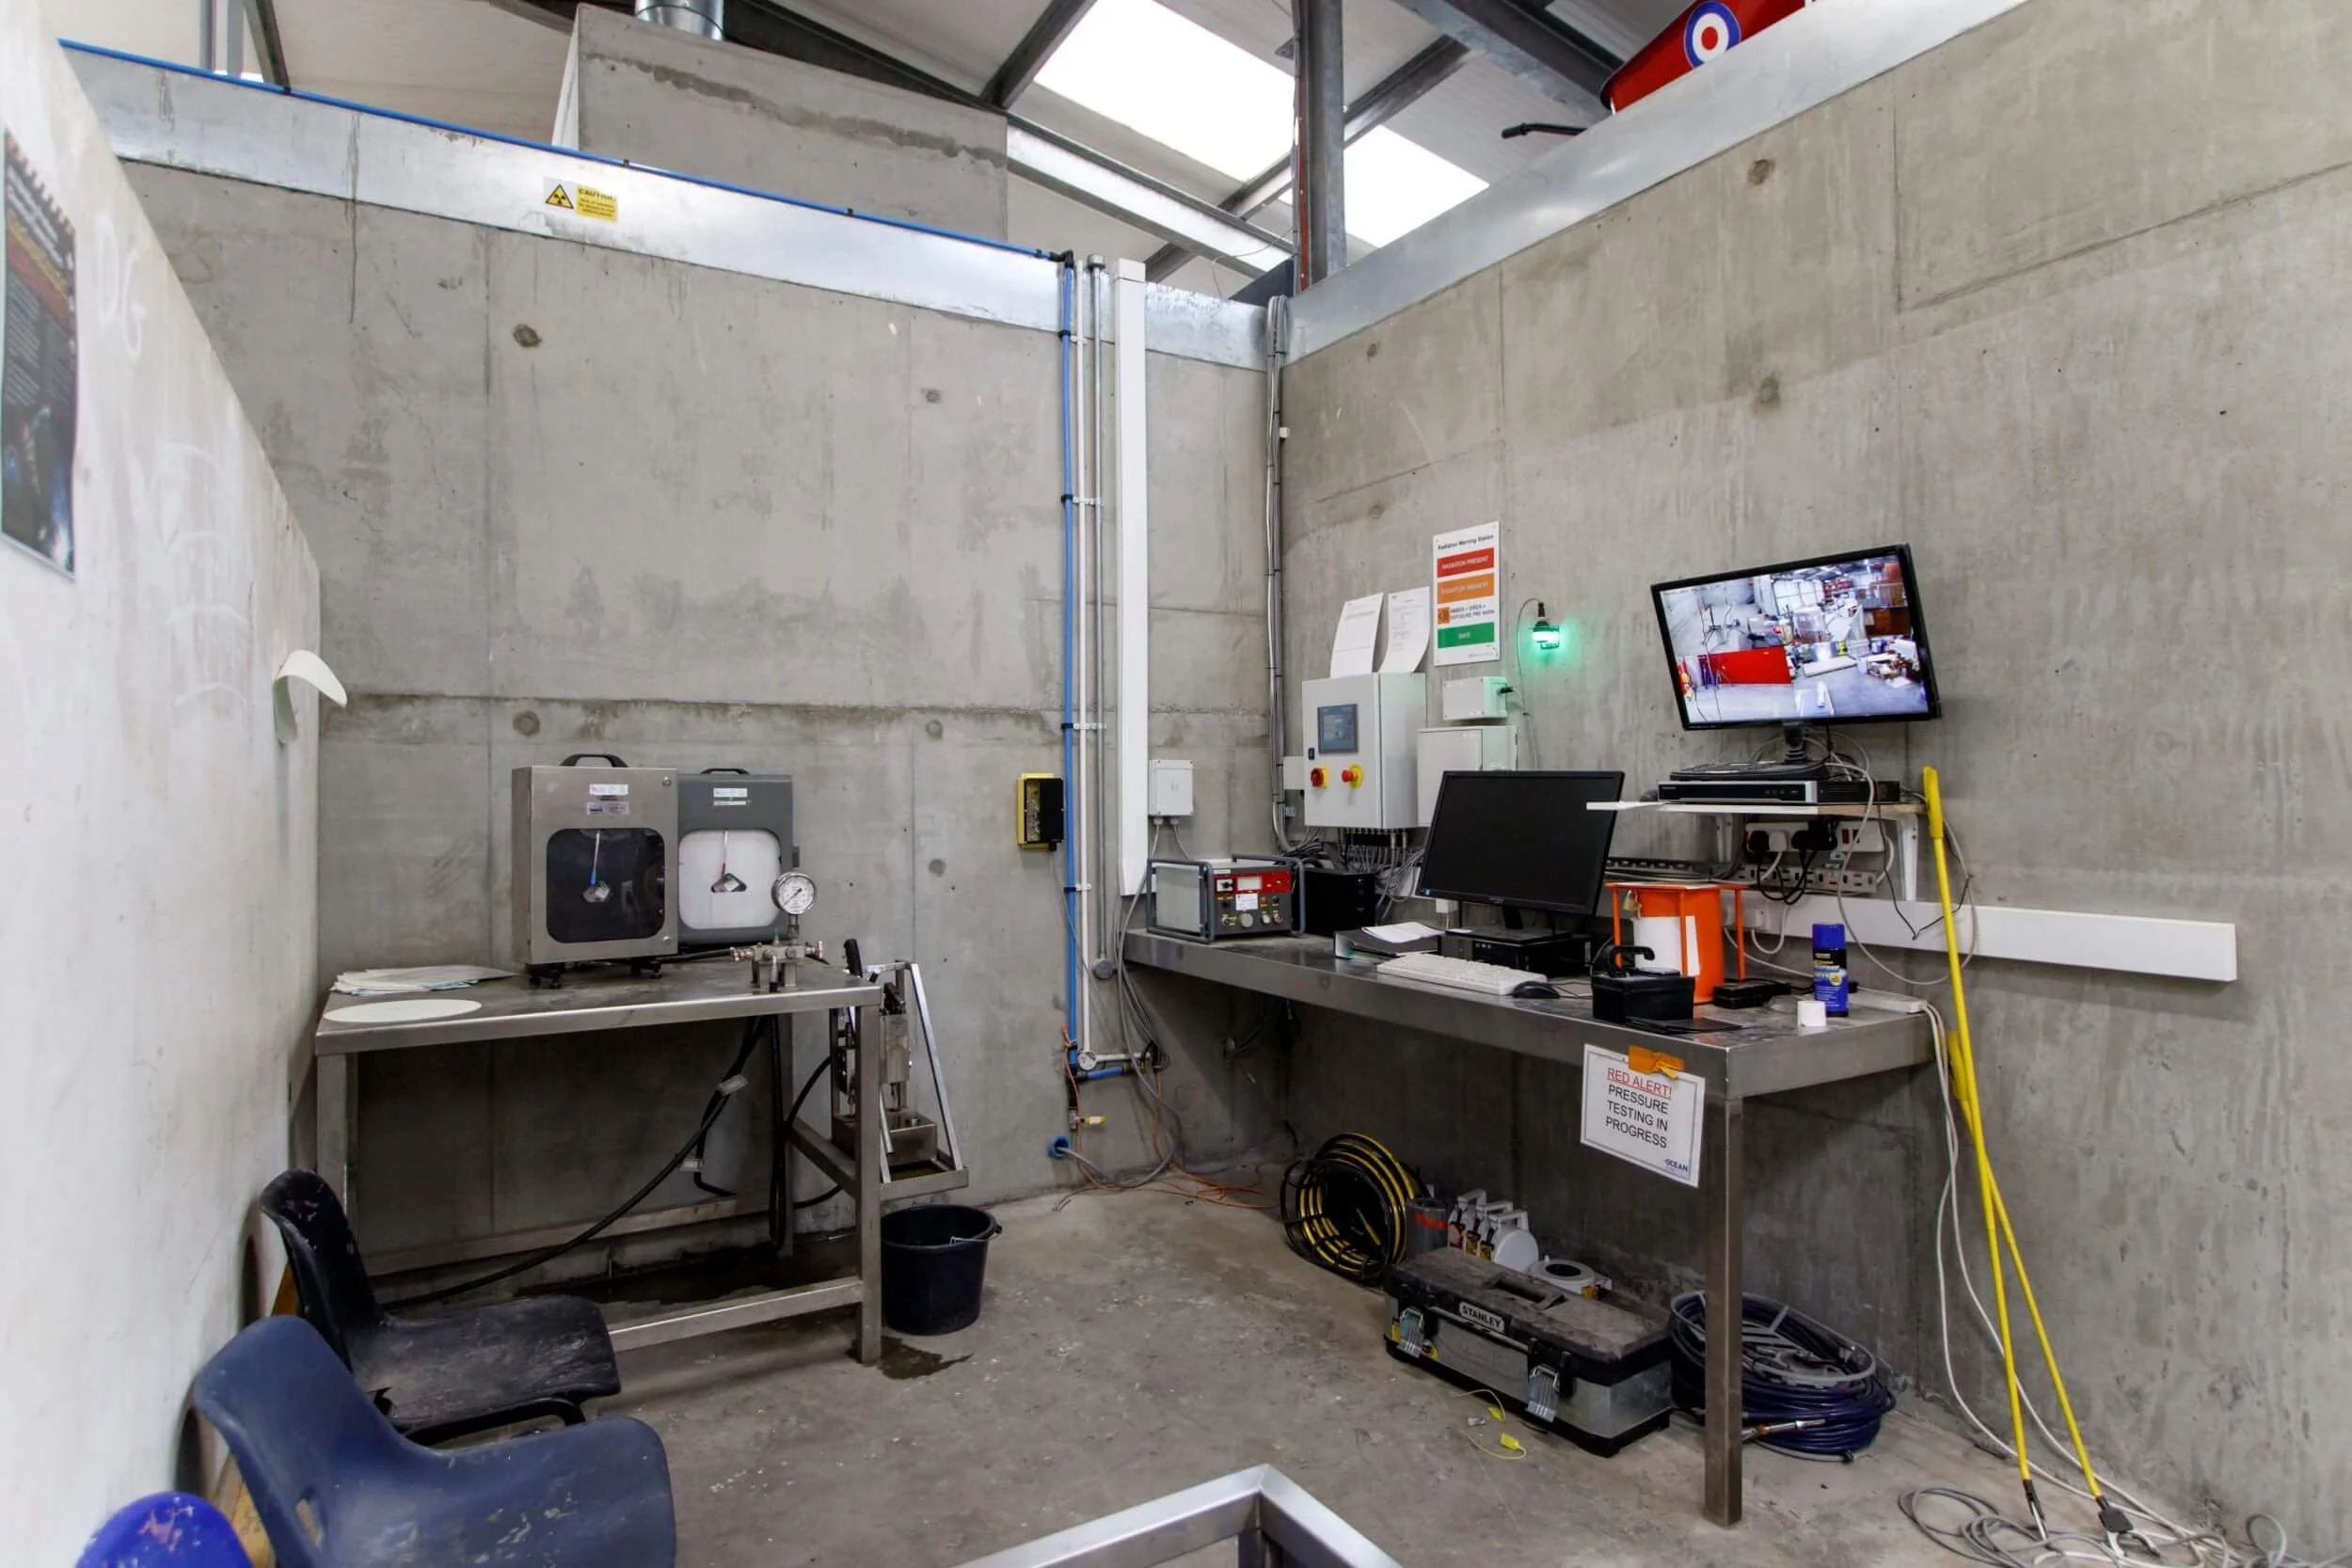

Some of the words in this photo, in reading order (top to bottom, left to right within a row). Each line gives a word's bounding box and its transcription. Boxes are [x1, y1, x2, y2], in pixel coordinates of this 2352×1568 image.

[1458, 537, 1476, 546] Warning
[1477, 534, 1494, 543] Station
[1607, 1068, 1630, 1083] RED
[1632, 1075, 1673, 1098] ALERT!
[1609, 1085, 1669, 1115] PRESSURE
[1607, 1100, 1654, 1125] TESTING
[1657, 1117, 1668, 1132] IN
[1605, 1117, 1667, 1148] PROGRESS
[1665, 1159, 1688, 1172] OCEAN
[1462, 1306, 1501, 1328] STANLEY
